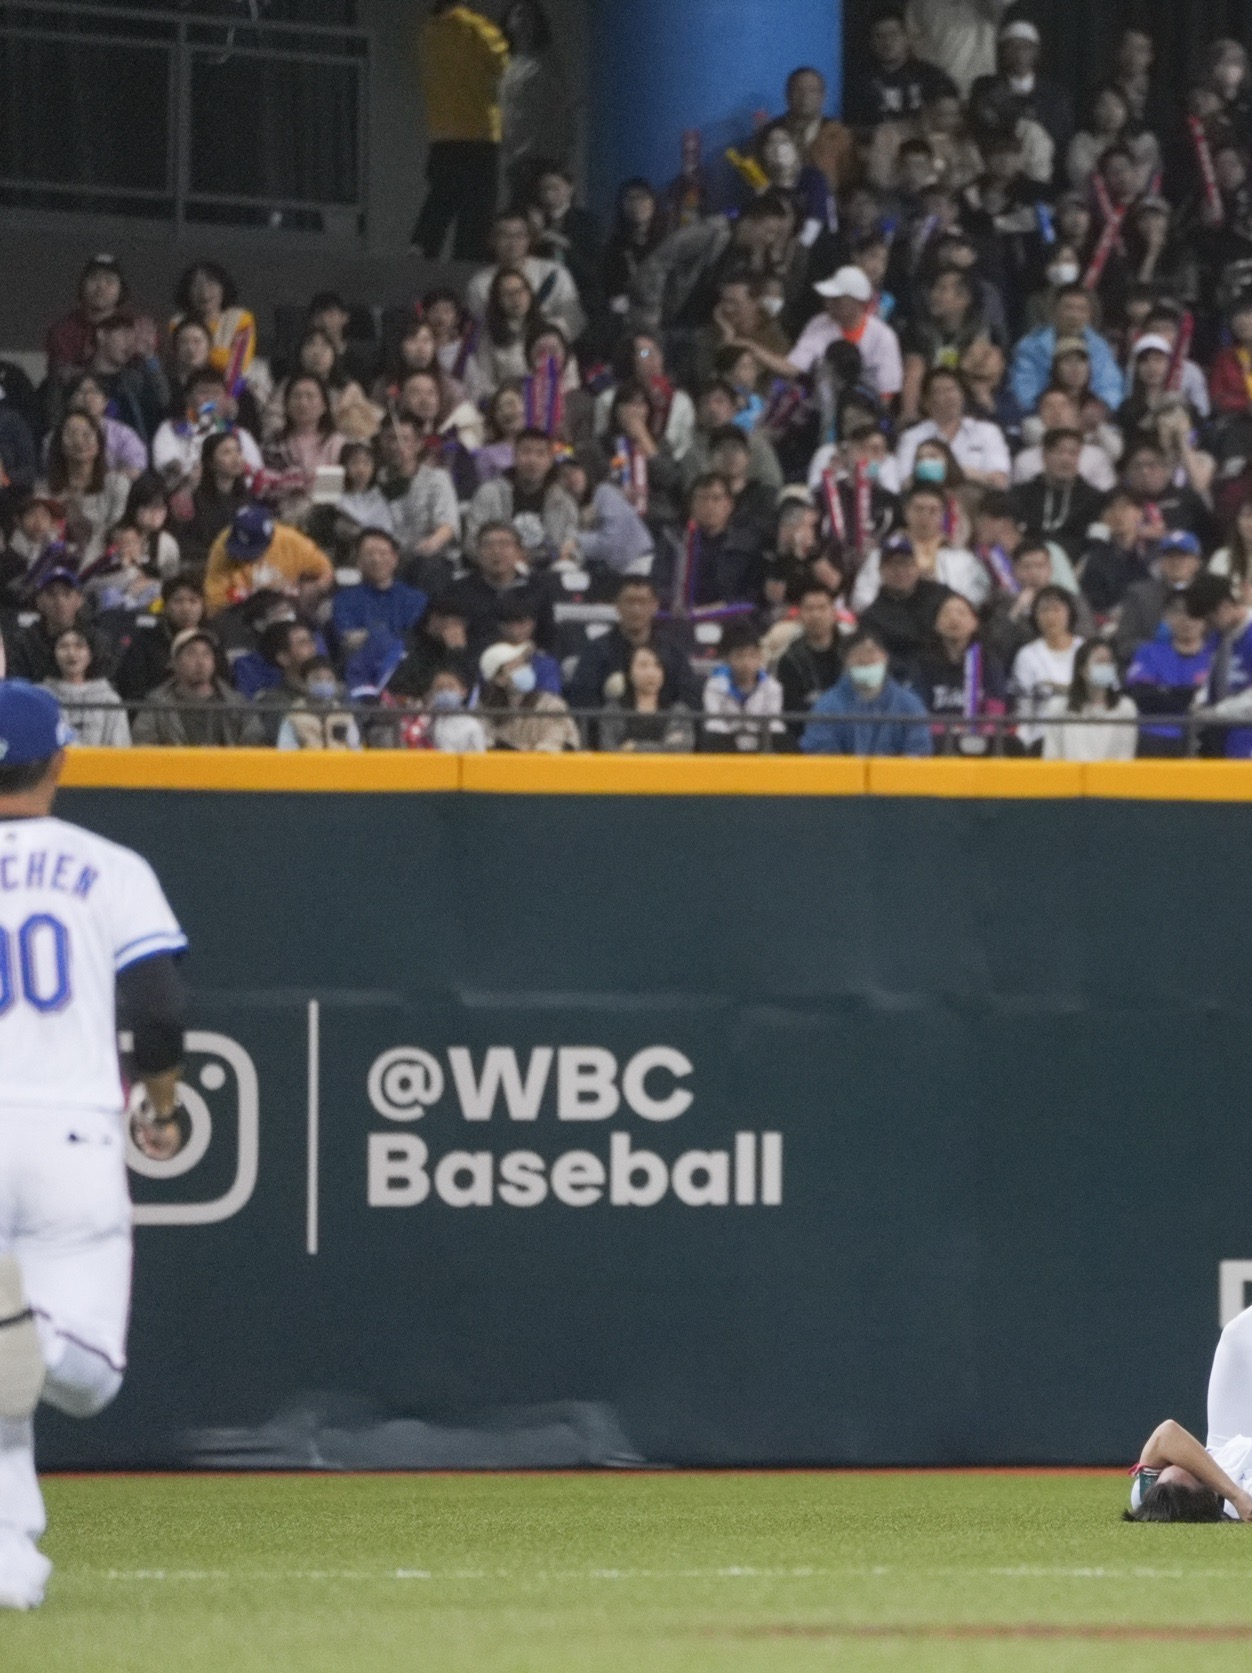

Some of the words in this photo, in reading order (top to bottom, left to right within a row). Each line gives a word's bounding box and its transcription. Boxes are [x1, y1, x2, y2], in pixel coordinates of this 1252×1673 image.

[0, 852, 98, 898] CHEN
[367, 1046, 695, 1122] @WBC
[367, 1132, 783, 1207] Baseball
